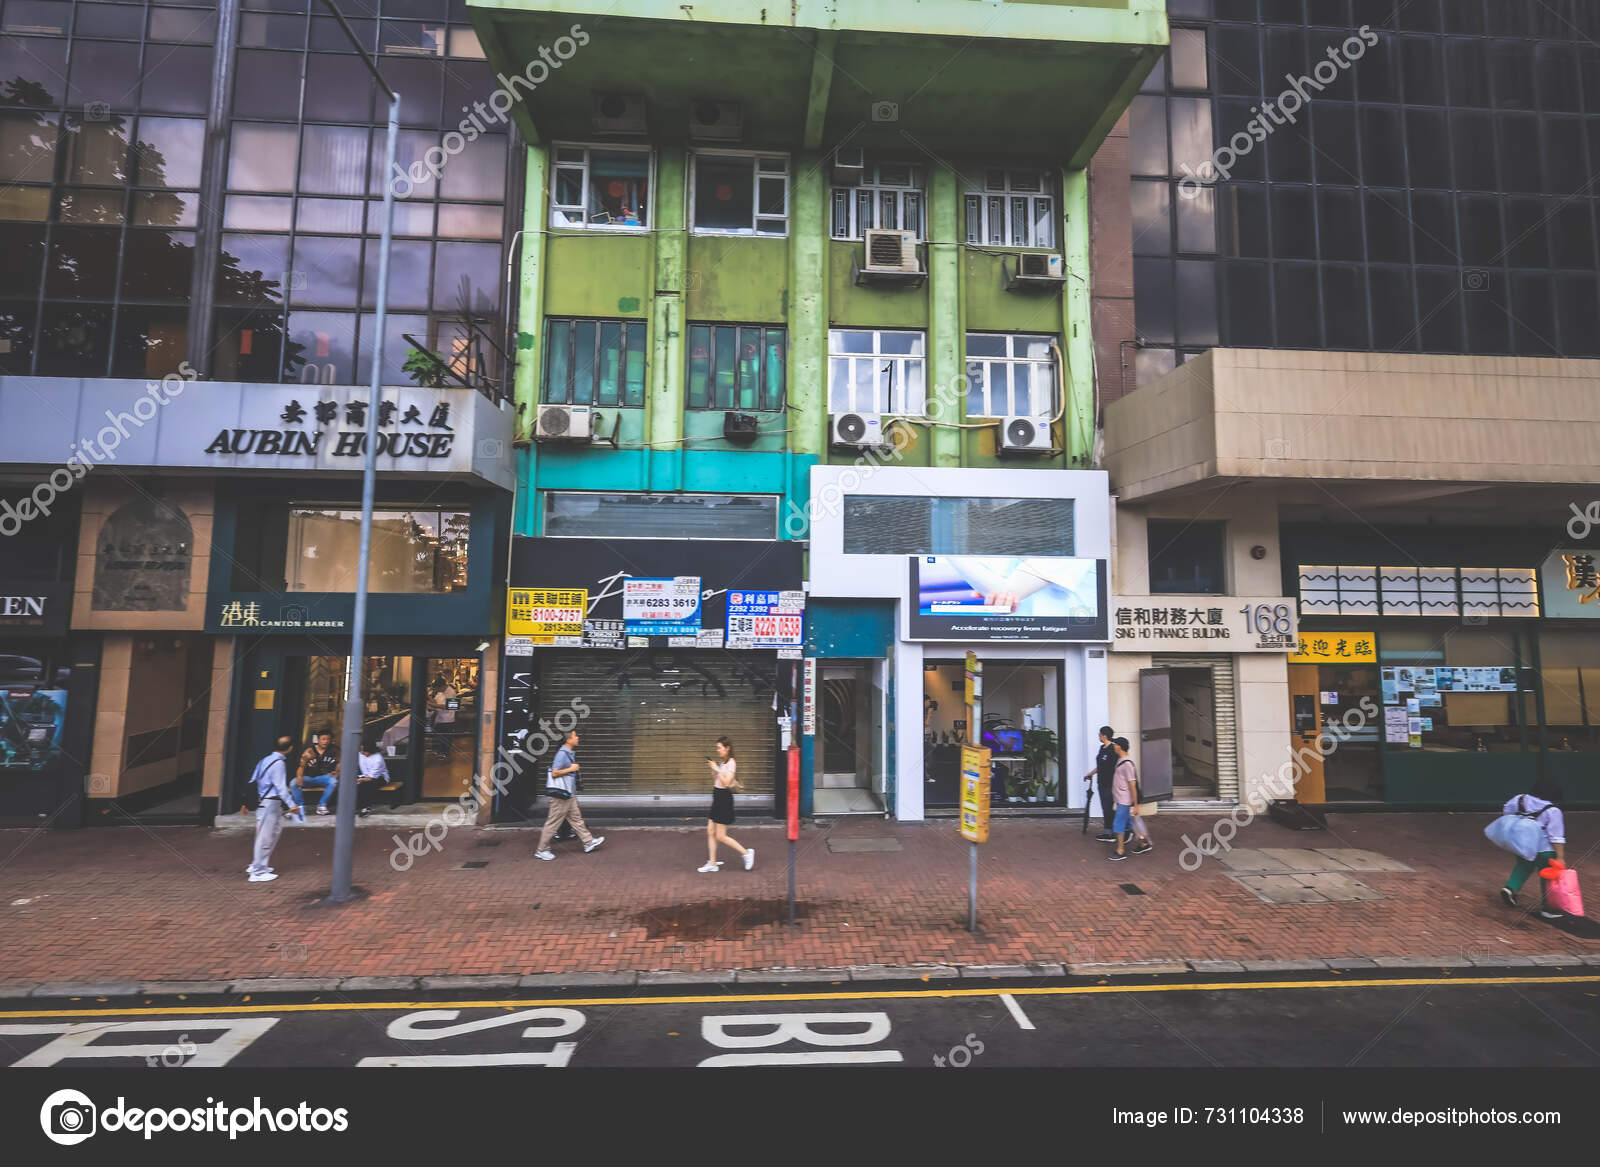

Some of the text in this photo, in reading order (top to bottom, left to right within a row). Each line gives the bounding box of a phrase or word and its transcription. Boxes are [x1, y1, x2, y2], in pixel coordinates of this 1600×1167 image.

[204, 430, 455, 458] AUBIN HOUSE
[0, 596, 47, 616] EN
[646, 599, 670, 608] 6283
[673, 599, 696, 608] 3619
[533, 608, 581, 622] 8100-2757
[1239, 604, 1294, 635] 168
[1115, 627, 1230, 639] SING HO FINANCE BUILDING
